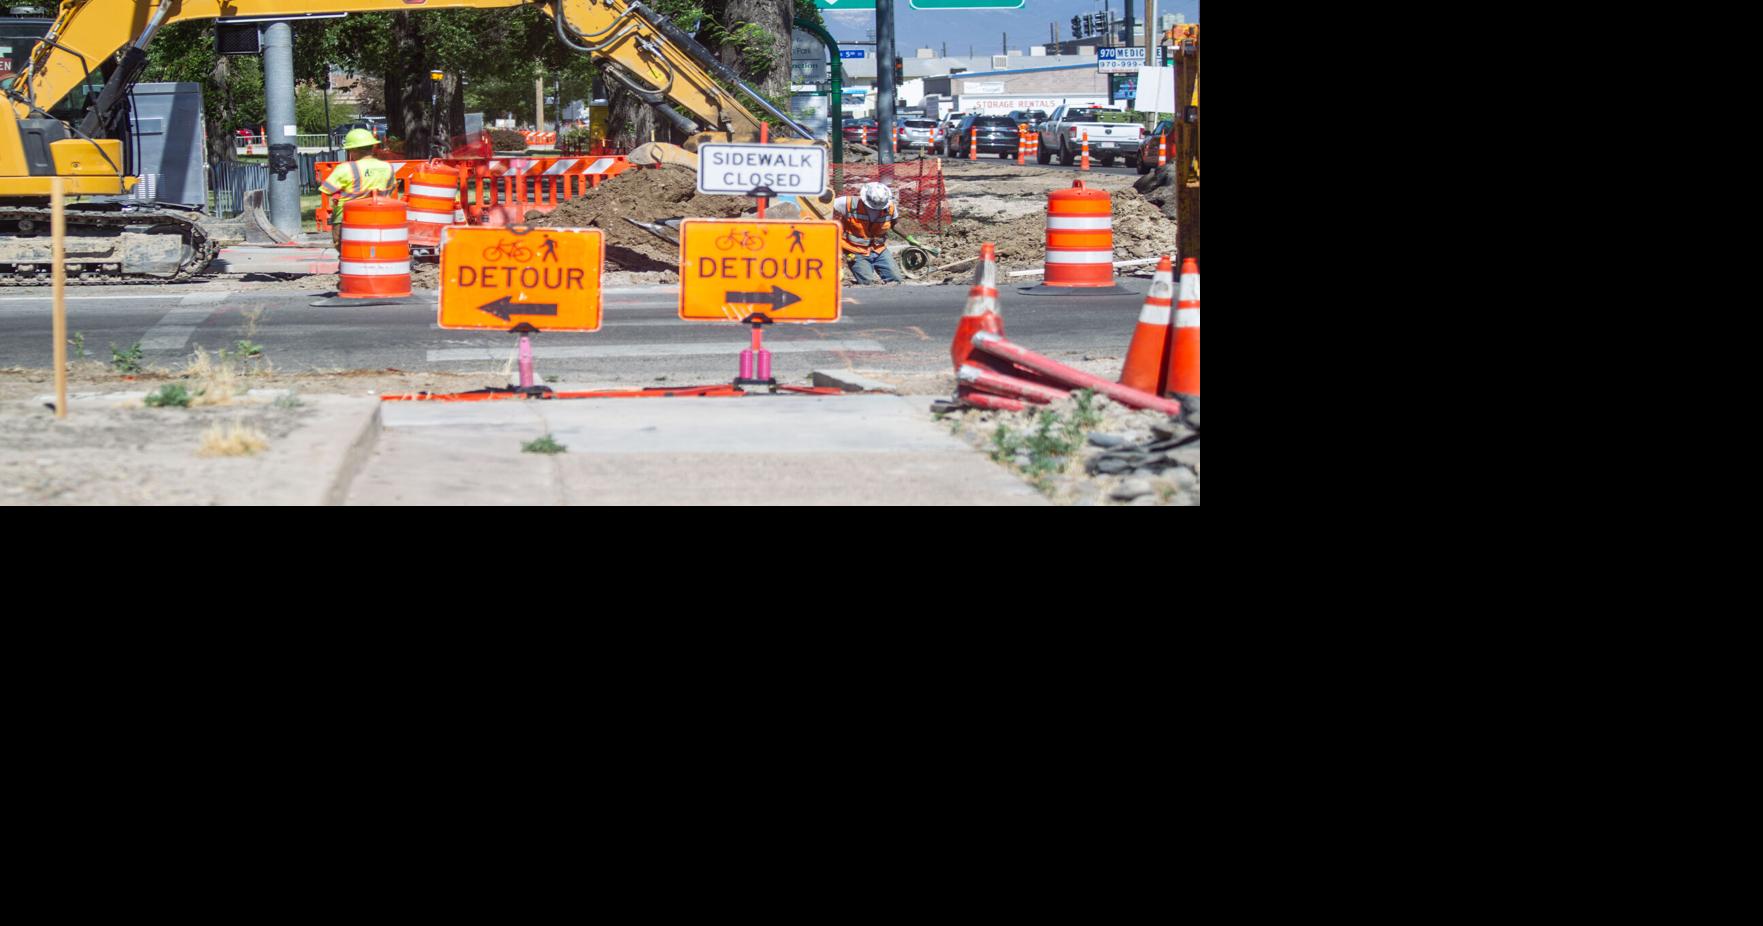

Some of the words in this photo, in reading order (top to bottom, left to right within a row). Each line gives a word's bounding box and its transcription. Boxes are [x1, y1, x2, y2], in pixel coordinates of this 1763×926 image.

[1100, 48, 1115, 58] 970
[1117, 48, 1161, 57] MEDICE
[976, 101, 1014, 109] STORAGE
[1018, 100, 1056, 108] RENTALS
[712, 152, 813, 168] SIDEWALK
[723, 172, 801, 187] CLOSED
[698, 256, 824, 280] DETOUR
[458, 265, 585, 289] DETOUR
